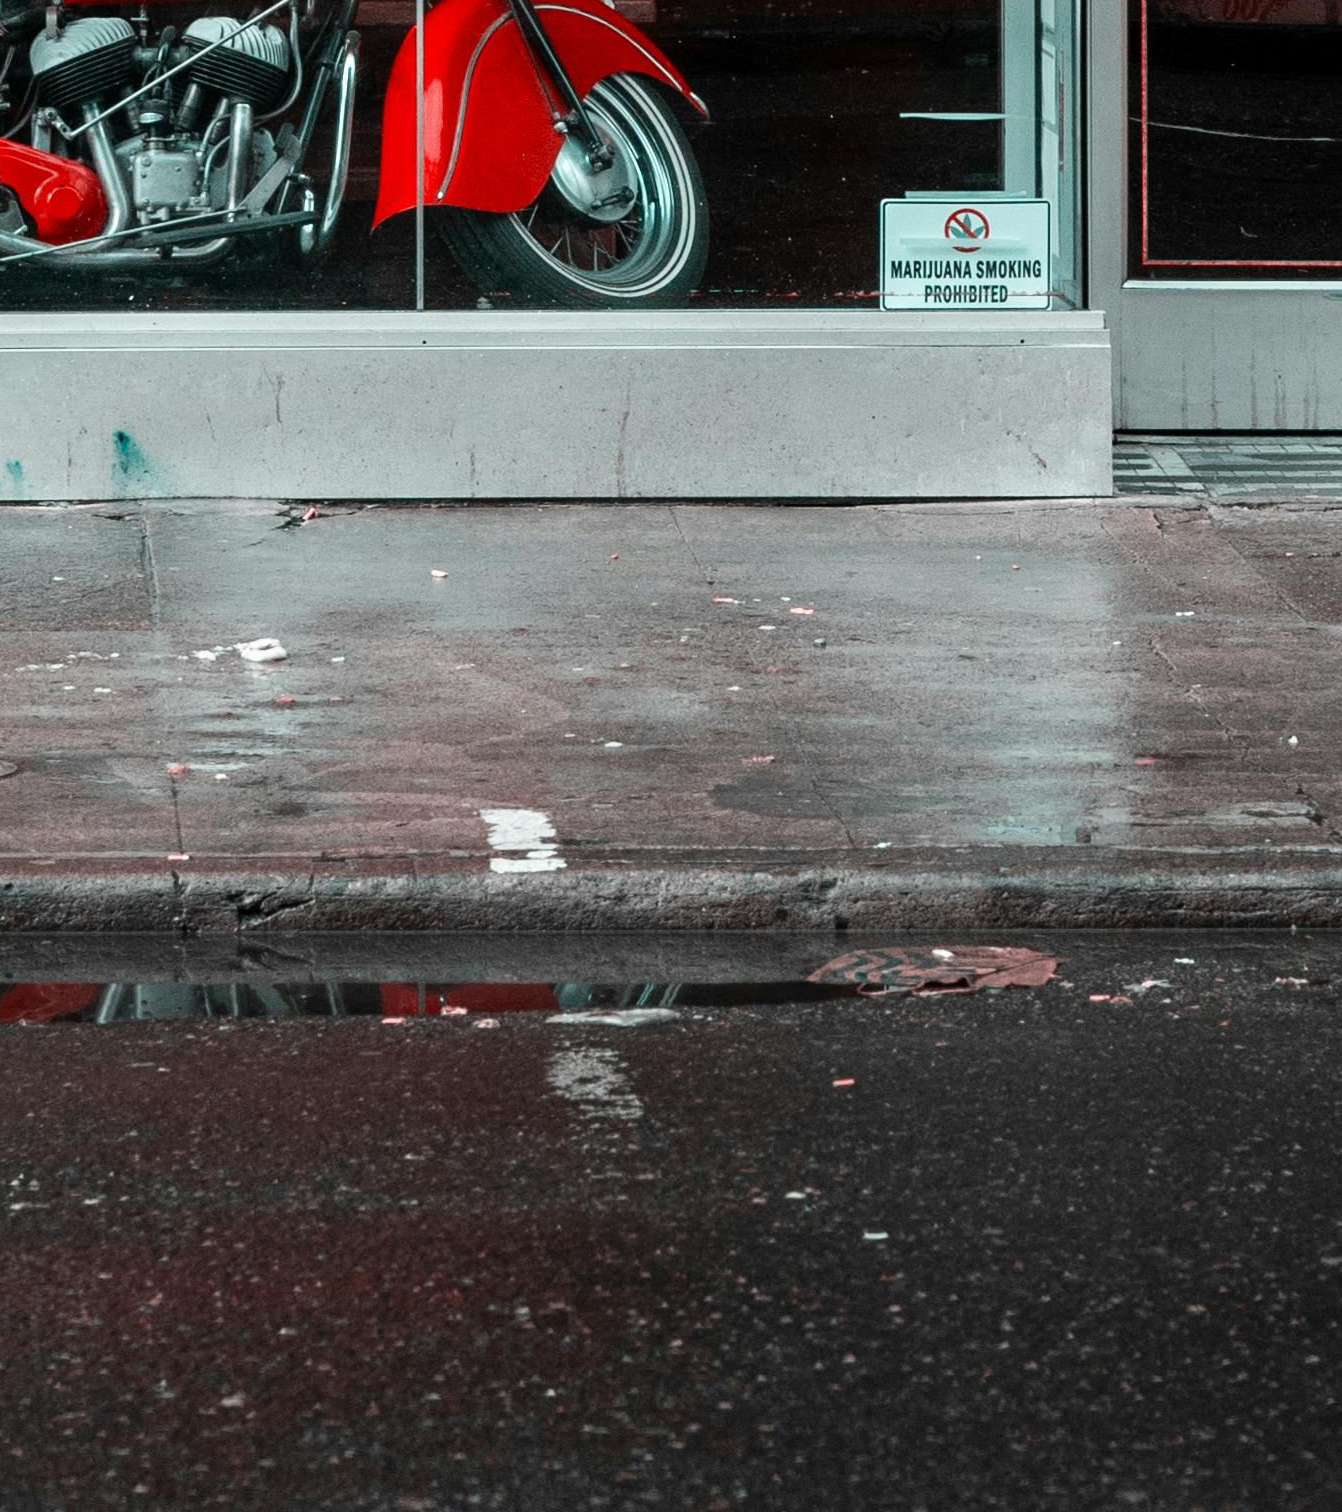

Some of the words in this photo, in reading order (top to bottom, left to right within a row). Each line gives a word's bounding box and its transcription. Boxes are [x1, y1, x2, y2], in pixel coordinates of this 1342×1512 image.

[890, 260, 972, 279] MARIJUANA
[975, 259, 1042, 279] SMOKING
[924, 285, 1009, 303] PROHIBITED
